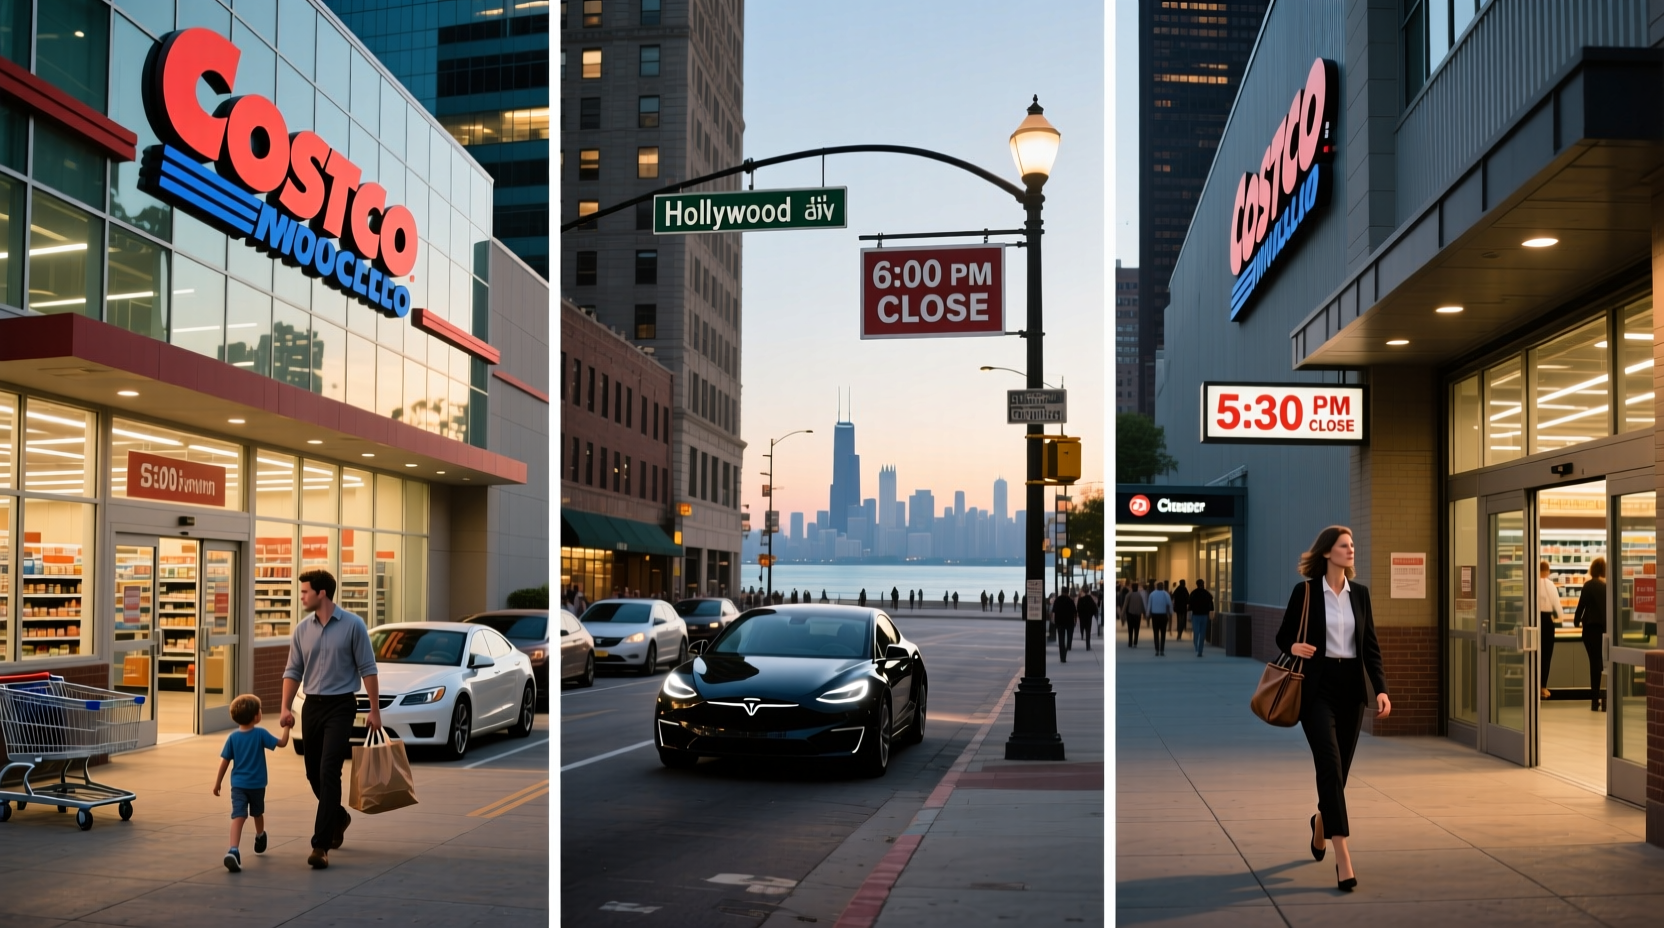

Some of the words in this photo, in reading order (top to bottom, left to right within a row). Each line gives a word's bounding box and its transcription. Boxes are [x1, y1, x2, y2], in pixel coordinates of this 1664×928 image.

[158, 27, 419, 278] COSTCO
[1229, 57, 1328, 276] COSTCO
[665, 196, 792, 231] Hollywood
[872, 258, 943, 290] 6:00
[950, 261, 993, 287] PM
[877, 292, 990, 324] CLOSE
[1216, 393, 1304, 431] 5:30
[1312, 395, 1351, 416] PM
[1308, 418, 1355, 433] CLOSE
